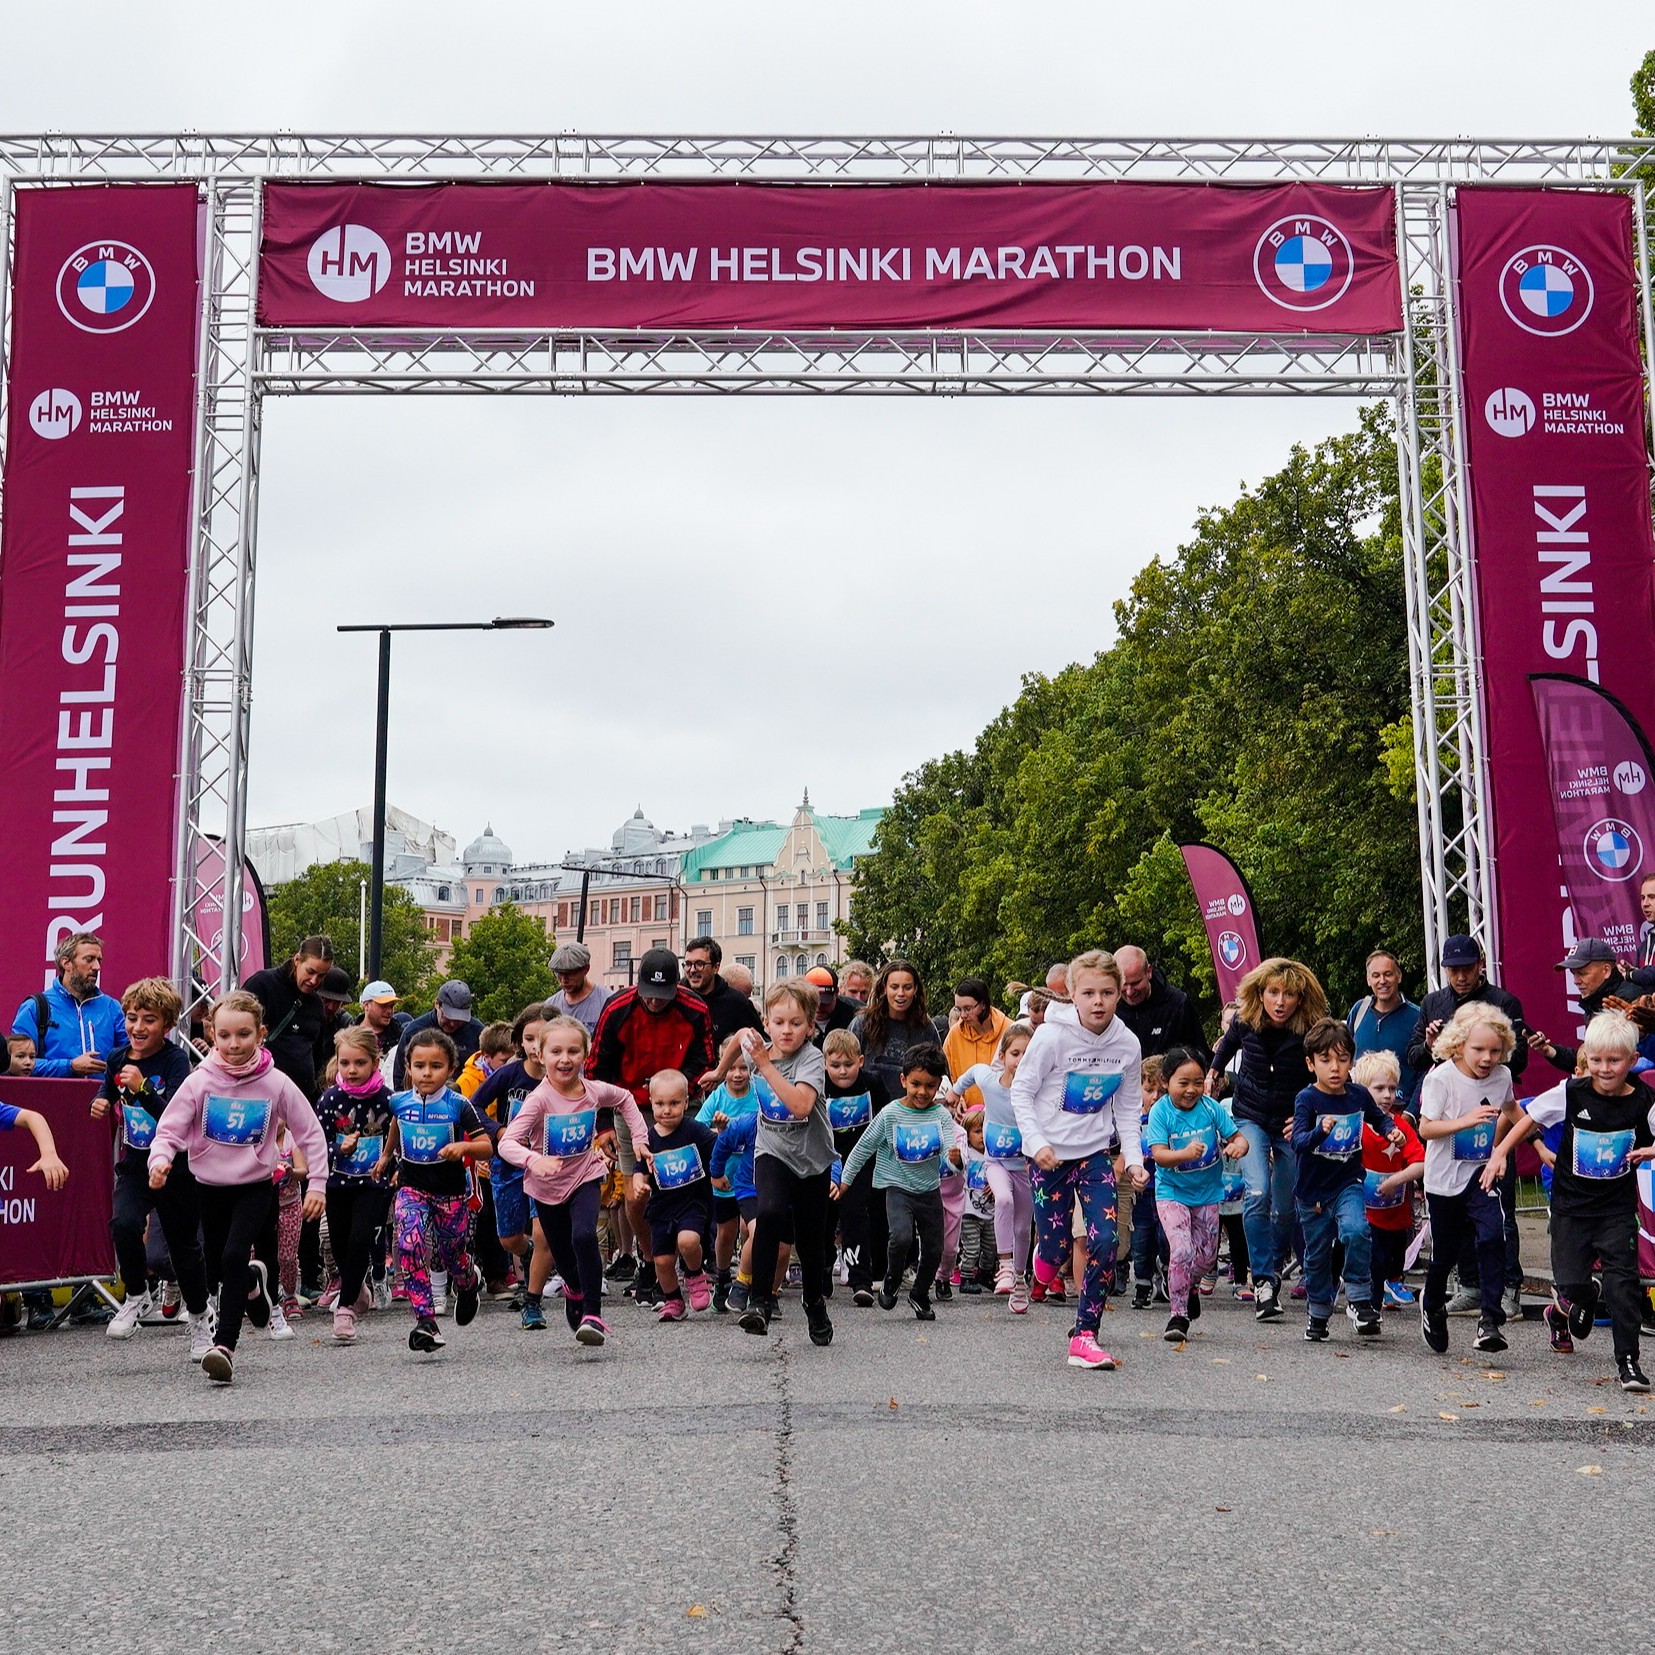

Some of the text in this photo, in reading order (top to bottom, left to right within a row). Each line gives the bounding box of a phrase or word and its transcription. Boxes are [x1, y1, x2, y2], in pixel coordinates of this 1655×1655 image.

[405, 231, 482, 255] BMW
[1269, 221, 1338, 248] BMW
[72, 247, 141, 272] BMW
[405, 258, 507, 276] HELSINKI
[587, 245, 1181, 282] BMW HELSINKI MARATHON
[1513, 250, 1578, 276] BMW
[404, 280, 535, 297] MARATHON
[90, 390, 141, 406] BMW
[1542, 393, 1590, 408] BMW
[90, 407, 156, 420] HELSINKI
[1543, 410, 1607, 421] HELSINKI
[89, 420, 173, 433] MARATHON
[1544, 422, 1624, 434] MARATHON
[45, 485, 125, 992] RUNHELSINKI
[1083, 1085, 1104, 1102] 56
[841, 1105, 859, 1119] 97
[129, 1119, 152, 1135] 94
[226, 1112, 246, 1130] 51
[561, 1124, 586, 1143] 133
[996, 1134, 1015, 1149] 85
[1333, 1126, 1352, 1141] 80
[1473, 1132, 1488, 1148] 18
[411, 1135, 437, 1151] 105
[905, 1134, 929, 1151] 145
[1595, 1146, 1617, 1165] 14
[664, 1159, 688, 1177] 130
